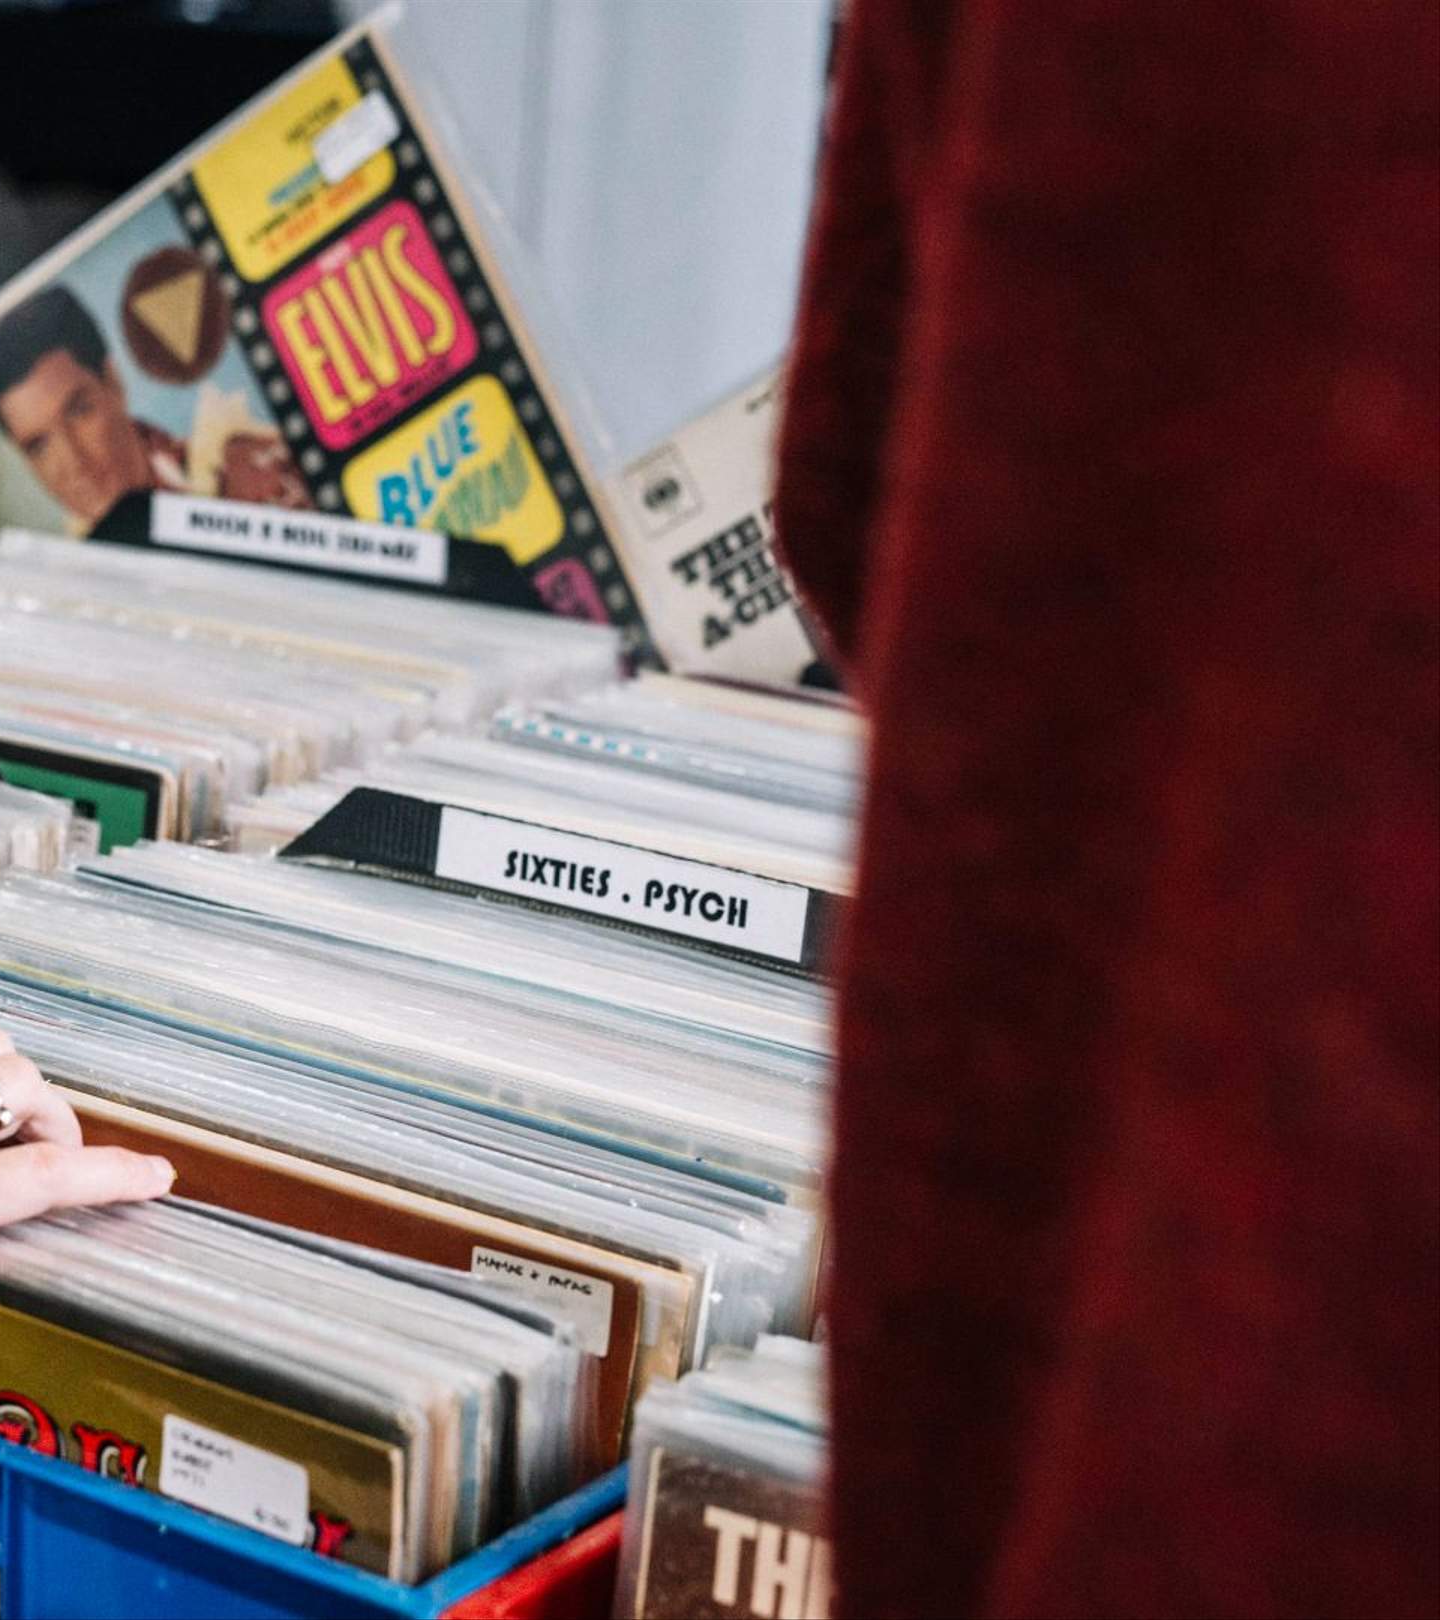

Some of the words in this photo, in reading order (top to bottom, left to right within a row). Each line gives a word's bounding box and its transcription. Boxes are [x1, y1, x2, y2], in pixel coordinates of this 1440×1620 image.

[274, 222, 456, 425] ELVIS
[377, 402, 478, 528] BLUE
[504, 849, 612, 898] SIXTIES
[643, 878, 749, 929] PSYCH
